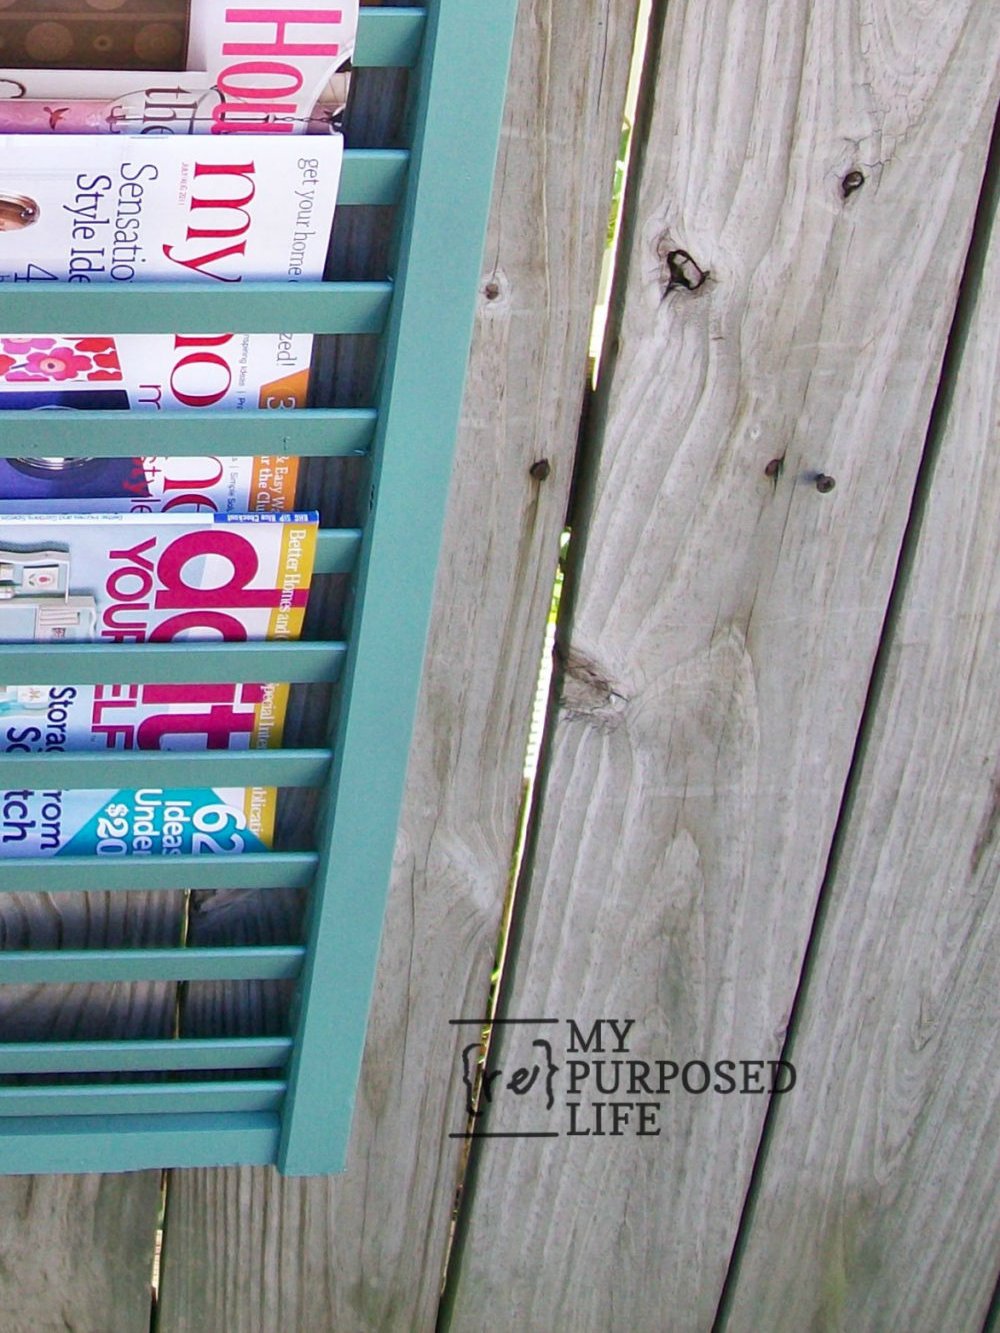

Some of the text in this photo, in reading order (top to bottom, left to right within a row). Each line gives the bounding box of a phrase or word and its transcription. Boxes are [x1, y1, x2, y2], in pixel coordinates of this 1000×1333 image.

[210, 9, 343, 136] Hou
[297, 158, 320, 186] get
[62, 173, 112, 240] Style
[110, 162, 159, 282] Sensatio
[162, 160, 256, 283] my
[294, 190, 316, 228] your
[287, 231, 316, 276] home
[258, 468, 272, 489] the
[269, 467, 290, 494] Easy
[227, 514, 259, 522] Checkout
[255, 492, 270, 512] Clu
[260, 514, 275, 522] Blue
[285, 529, 307, 571] Better
[279, 574, 300, 612] Homes
[274, 614, 288, 634] and
[39, 790, 63, 850] rom
[95, 804, 129, 856] $20
[191, 804, 246, 855] 62
